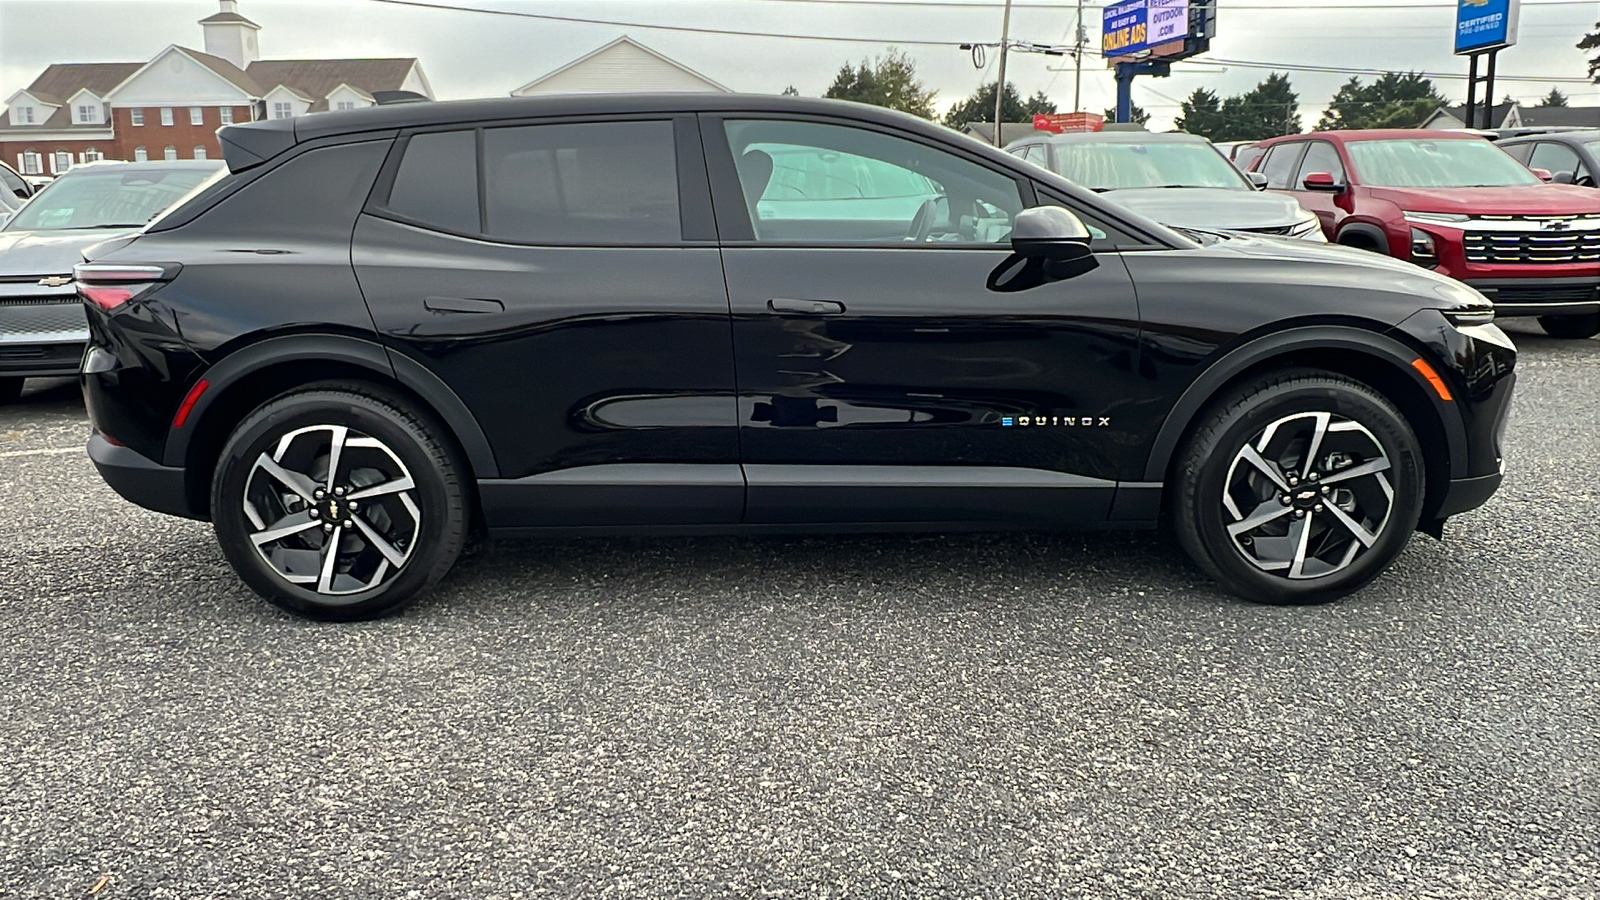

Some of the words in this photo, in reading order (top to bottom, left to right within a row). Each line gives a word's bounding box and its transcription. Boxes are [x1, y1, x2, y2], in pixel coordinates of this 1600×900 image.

[1104, 8, 1118, 19] LOCAL
[1111, 21, 1118, 29] AS
[1118, 16, 1130, 27] EASY
[1129, 15, 1137, 24] AS
[1459, 13, 1503, 29] CERTIFIED
[1158, 24, 1175, 37] .COM
[1460, 21, 1500, 36] PRE-OWNED
[1103, 27, 1130, 50] ONLINE
[1130, 23, 1146, 44] ADS
[1002, 416, 1110, 427] EQUINOX
